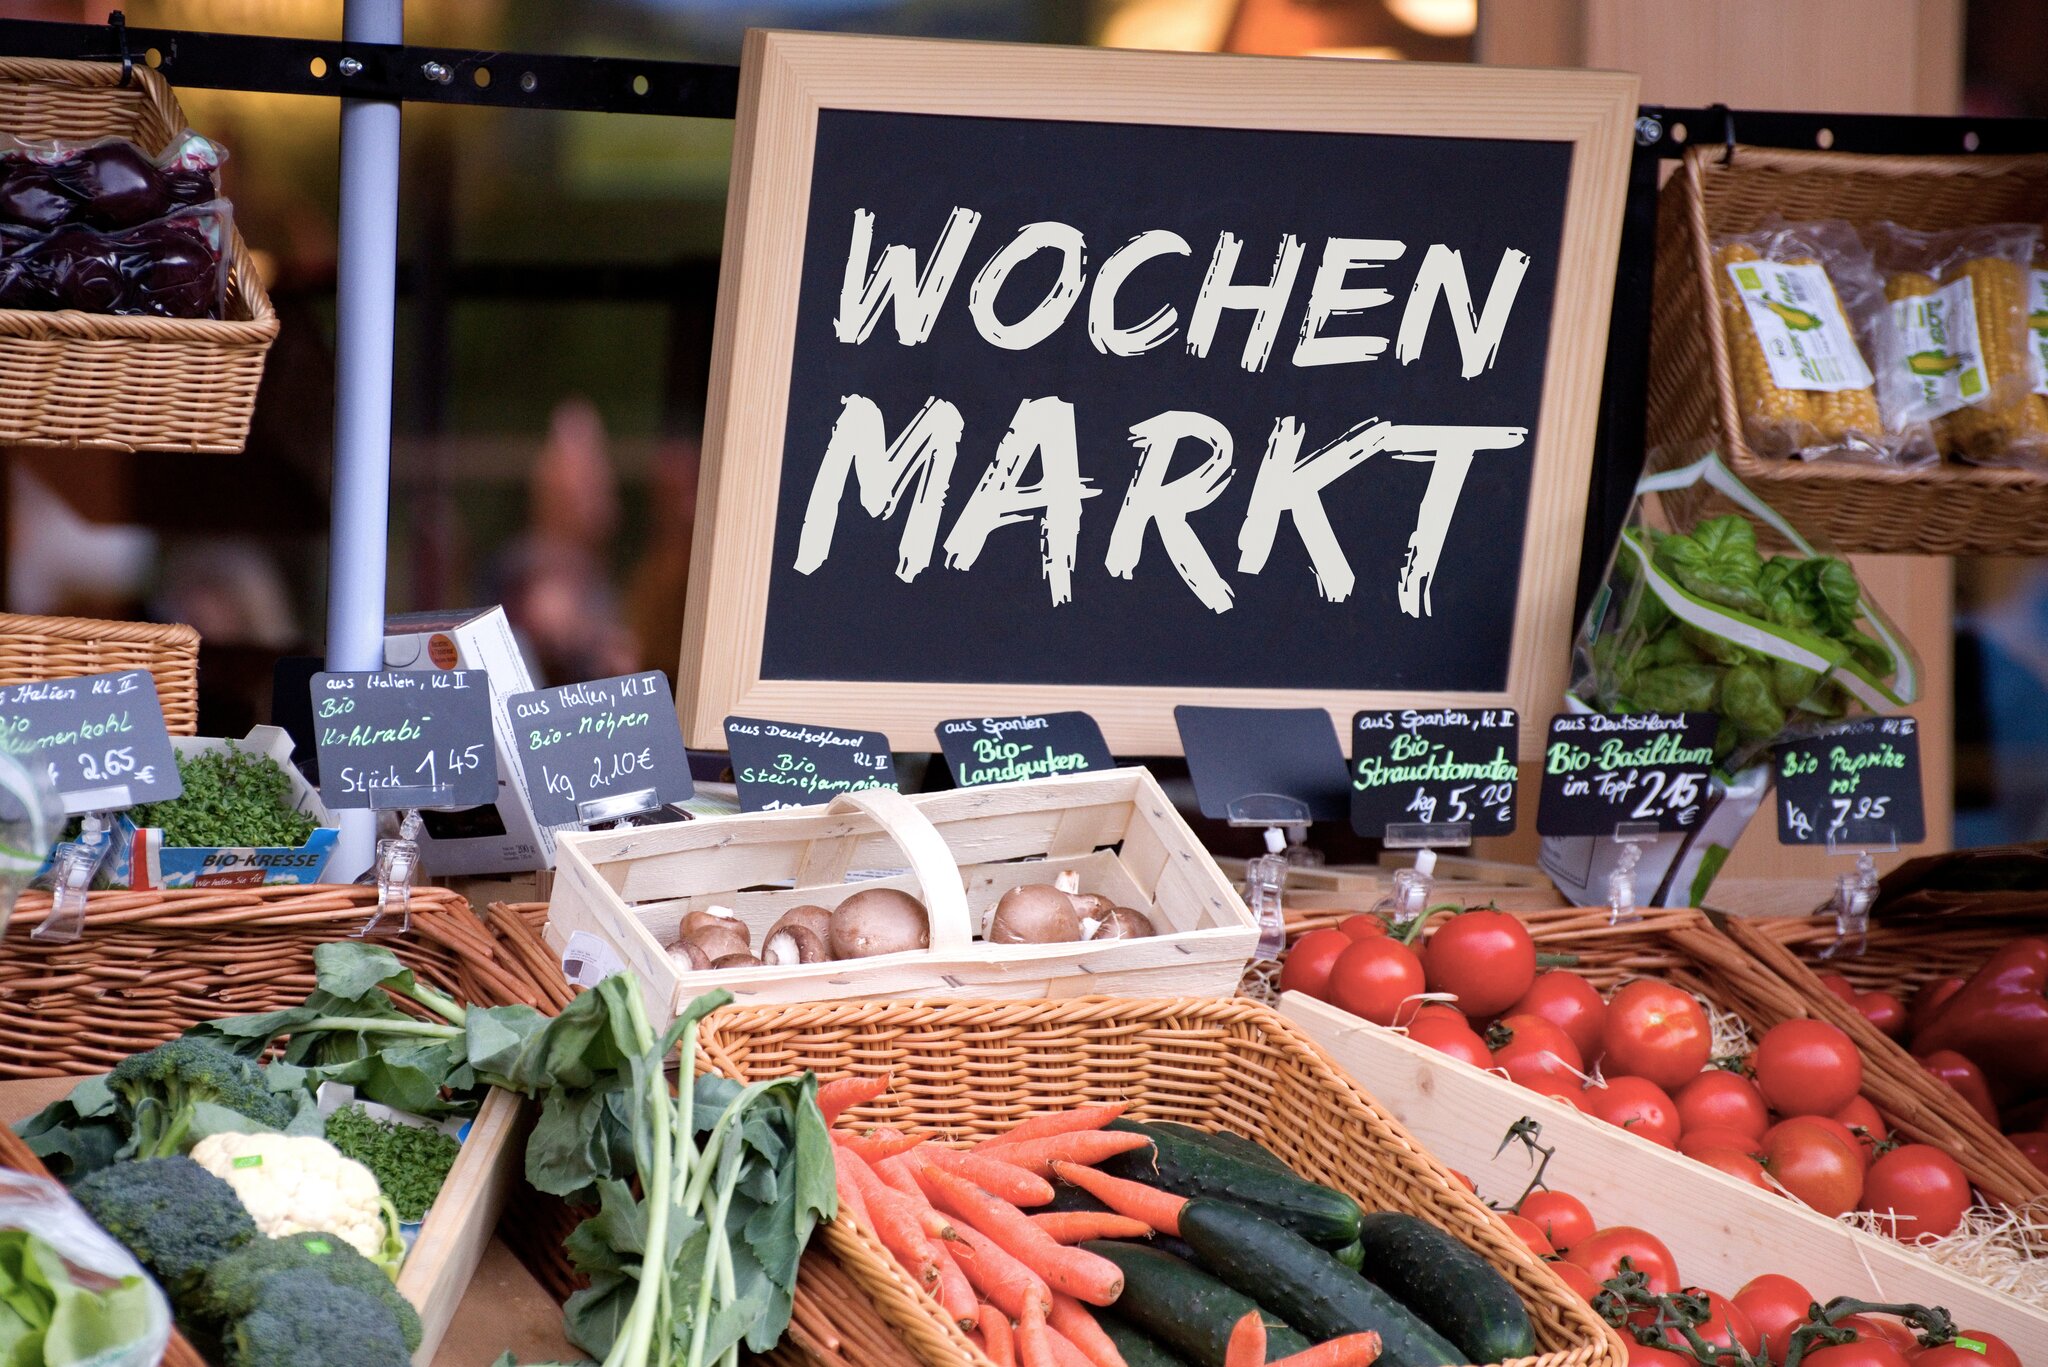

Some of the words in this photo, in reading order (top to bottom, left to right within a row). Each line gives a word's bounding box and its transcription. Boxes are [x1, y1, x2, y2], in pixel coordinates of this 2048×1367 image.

[834, 206, 1531, 380] WOCHEN
[793, 395, 1529, 619] MARKT
[326, 678, 355, 690] aus
[517, 699, 550, 718] aus
[642, 676, 657, 696] II
[319, 697, 355, 718] Bio
[1359, 713, 1395, 730] aus
[729, 722, 760, 736] aus
[945, 720, 977, 734] aus
[982, 716, 1049, 740] Spanien
[1554, 717, 1586, 732] aus
[1590, 712, 1689, 732] Deutschland
[972, 738, 1033, 763] Bio-
[1390, 734, 1446, 762] Bio-
[1546, 732, 1714, 775] Bio-Basilikum
[1782, 751, 1818, 777] Bio
[1829, 743, 1906, 775] Paprika
[773, 754, 816, 773] Bio
[960, 746, 1089, 787] Landgurken
[1353, 746, 1519, 791] Strauchtomaten
[341, 765, 401, 793] Stück
[542, 765, 576, 801] kg
[1562, 774, 1590, 797] im
[1594, 769, 1638, 804] Topf
[1828, 772, 1860, 794] rot
[1405, 786, 1437, 824] kg
[1786, 799, 1813, 840] kg
[203, 854, 319, 867] BIO-KRESSE
